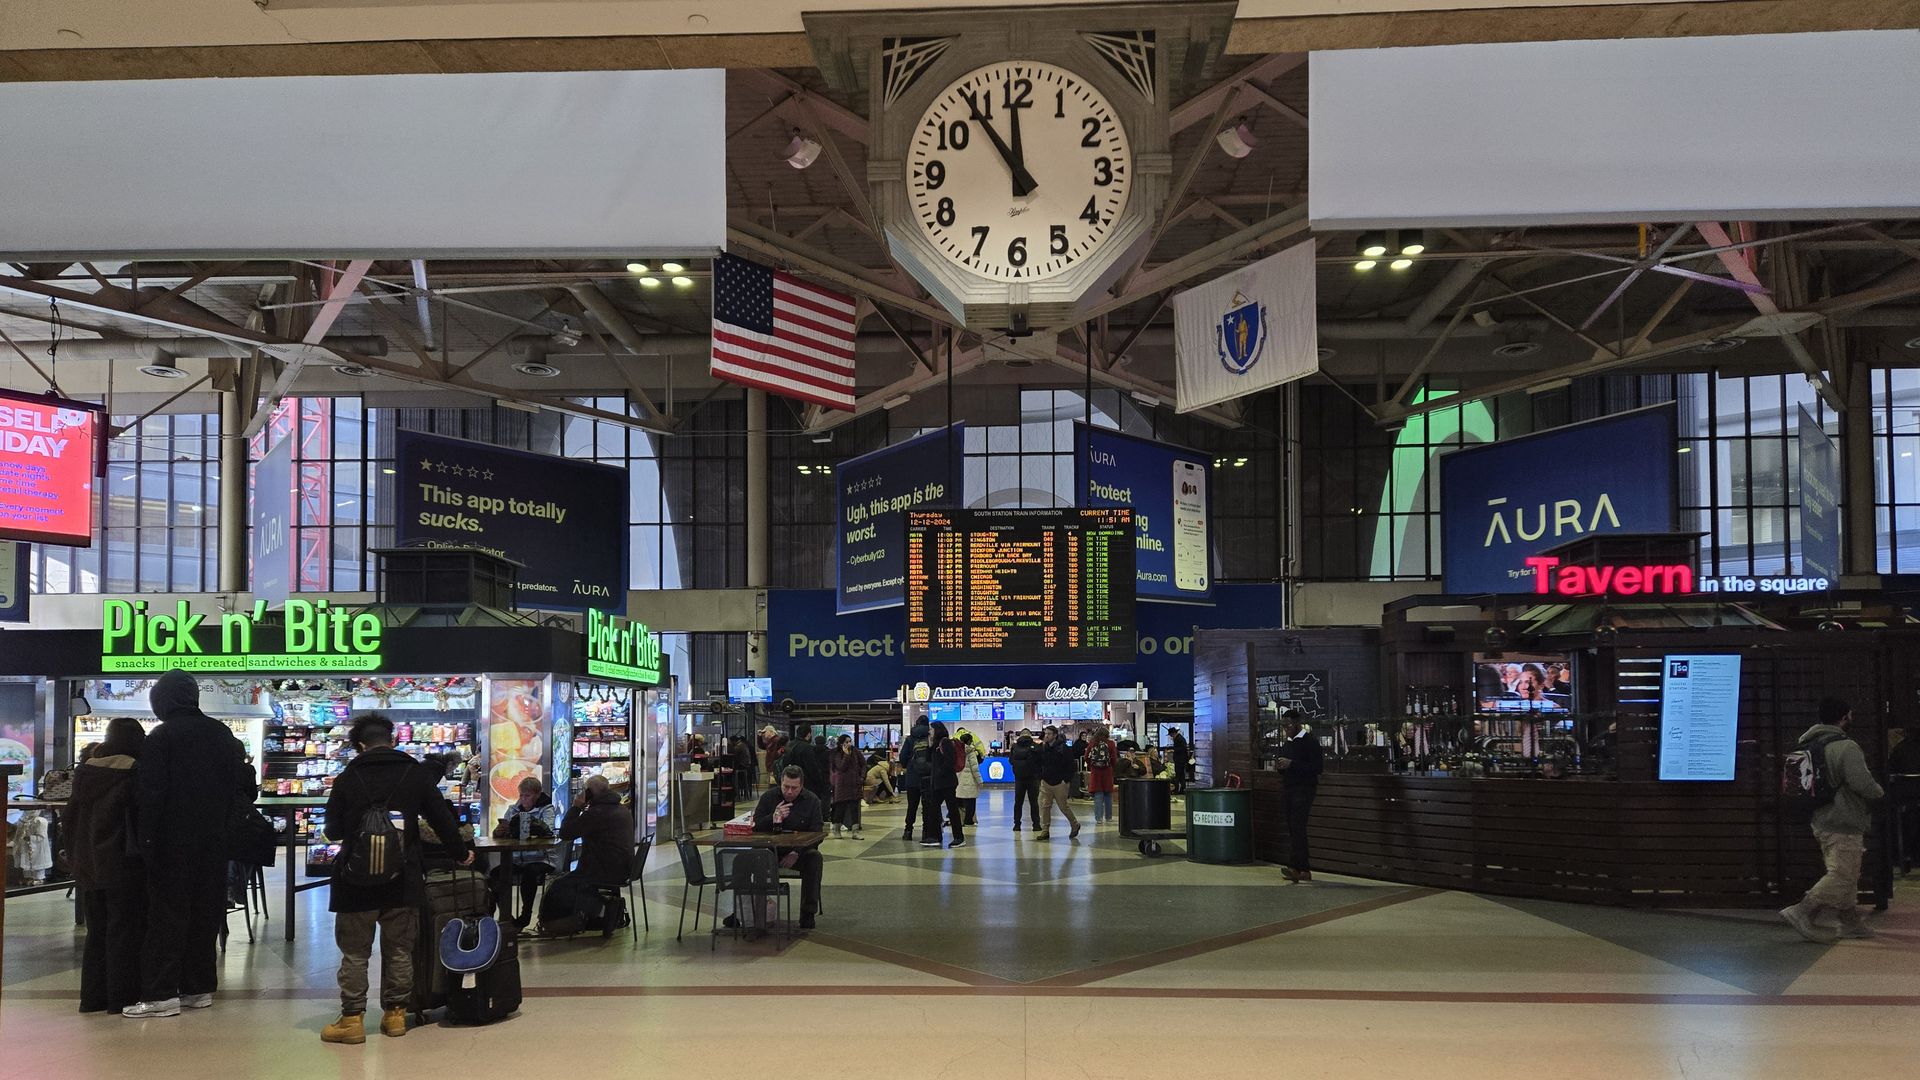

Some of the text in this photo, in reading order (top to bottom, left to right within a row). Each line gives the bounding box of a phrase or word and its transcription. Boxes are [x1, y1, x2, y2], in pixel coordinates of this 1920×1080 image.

[969, 90, 994, 120] 11
[1002, 78, 1034, 108] 12
[1055, 88, 1065, 118] 1
[937, 120, 969, 150] 10
[1081, 117, 1101, 147] 2
[925, 160, 946, 190] 9
[1094, 156, 1113, 186] 3
[936, 197, 956, 226] 8
[1079, 195, 1100, 224] 4
[972, 226, 990, 257] 7
[1007, 237, 1027, 268] 6
[1050, 225, 1069, 256] 5
[419, 483, 566, 524] This app totally
[846, 482, 944, 524] Ugh, this app is the
[1090, 480, 1131, 503] Protect
[418, 511, 484, 533] sucks.
[847, 523, 877, 544] worst.
[1136, 534, 1164, 552] nline.
[522, 582, 558, 592] predators.
[1136, 570, 1168, 582] Aura.com
[1525, 557, 1692, 595] Tavern
[1701, 576, 1719, 592] in
[1723, 576, 1756, 592] the
[1760, 576, 1828, 594] square
[102, 599, 207, 654] Pick
[285, 599, 383, 653] Bite
[588, 608, 618, 662] Pick
[636, 622, 659, 670] Bite
[789, 634, 894, 657] Protect
[1136, 630, 1157, 654] o
[115, 658, 156, 668] snacks
[172, 657, 198, 668] chef
[200, 657, 245, 668] created
[248, 656, 317, 667] sandwiches
[319, 657, 330, 666] &
[331, 657, 368, 667] salads
[1047, 682, 1085, 699] Carvel
